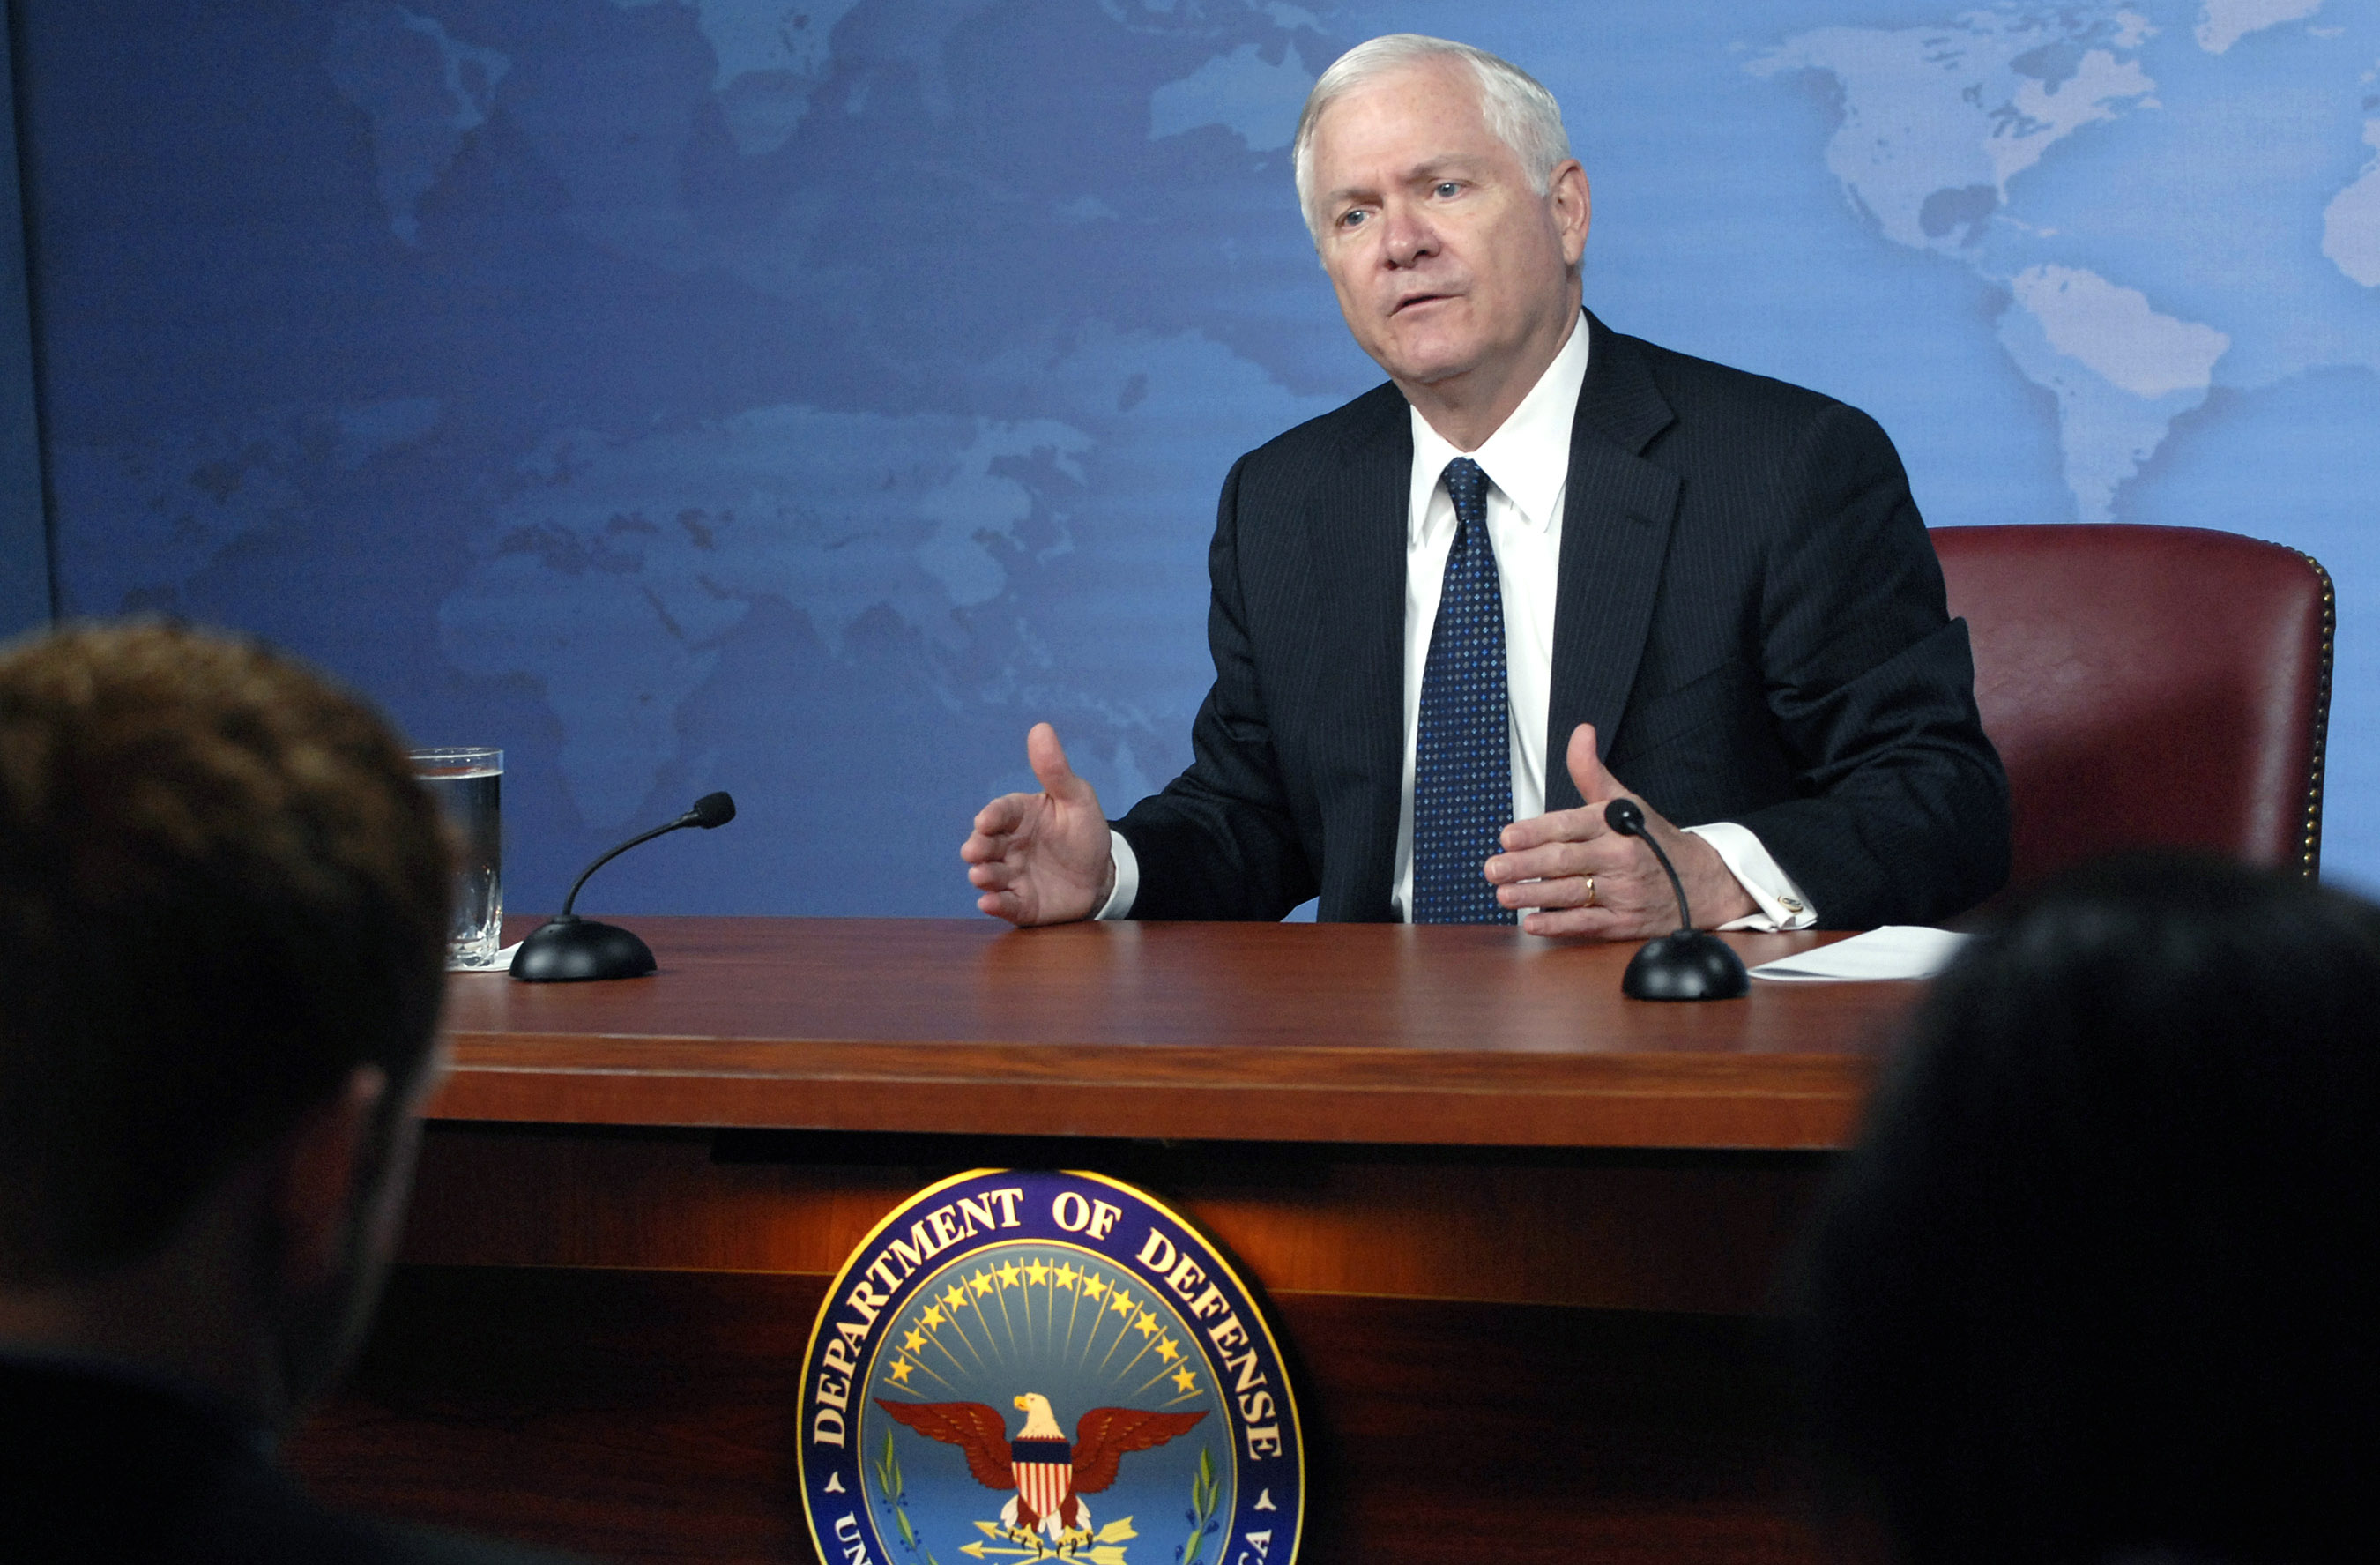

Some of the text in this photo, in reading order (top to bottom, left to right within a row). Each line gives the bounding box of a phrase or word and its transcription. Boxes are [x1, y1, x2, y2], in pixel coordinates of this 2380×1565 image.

[813, 1187, 1283, 1461] DEPARTMENT OF DEFENSE
